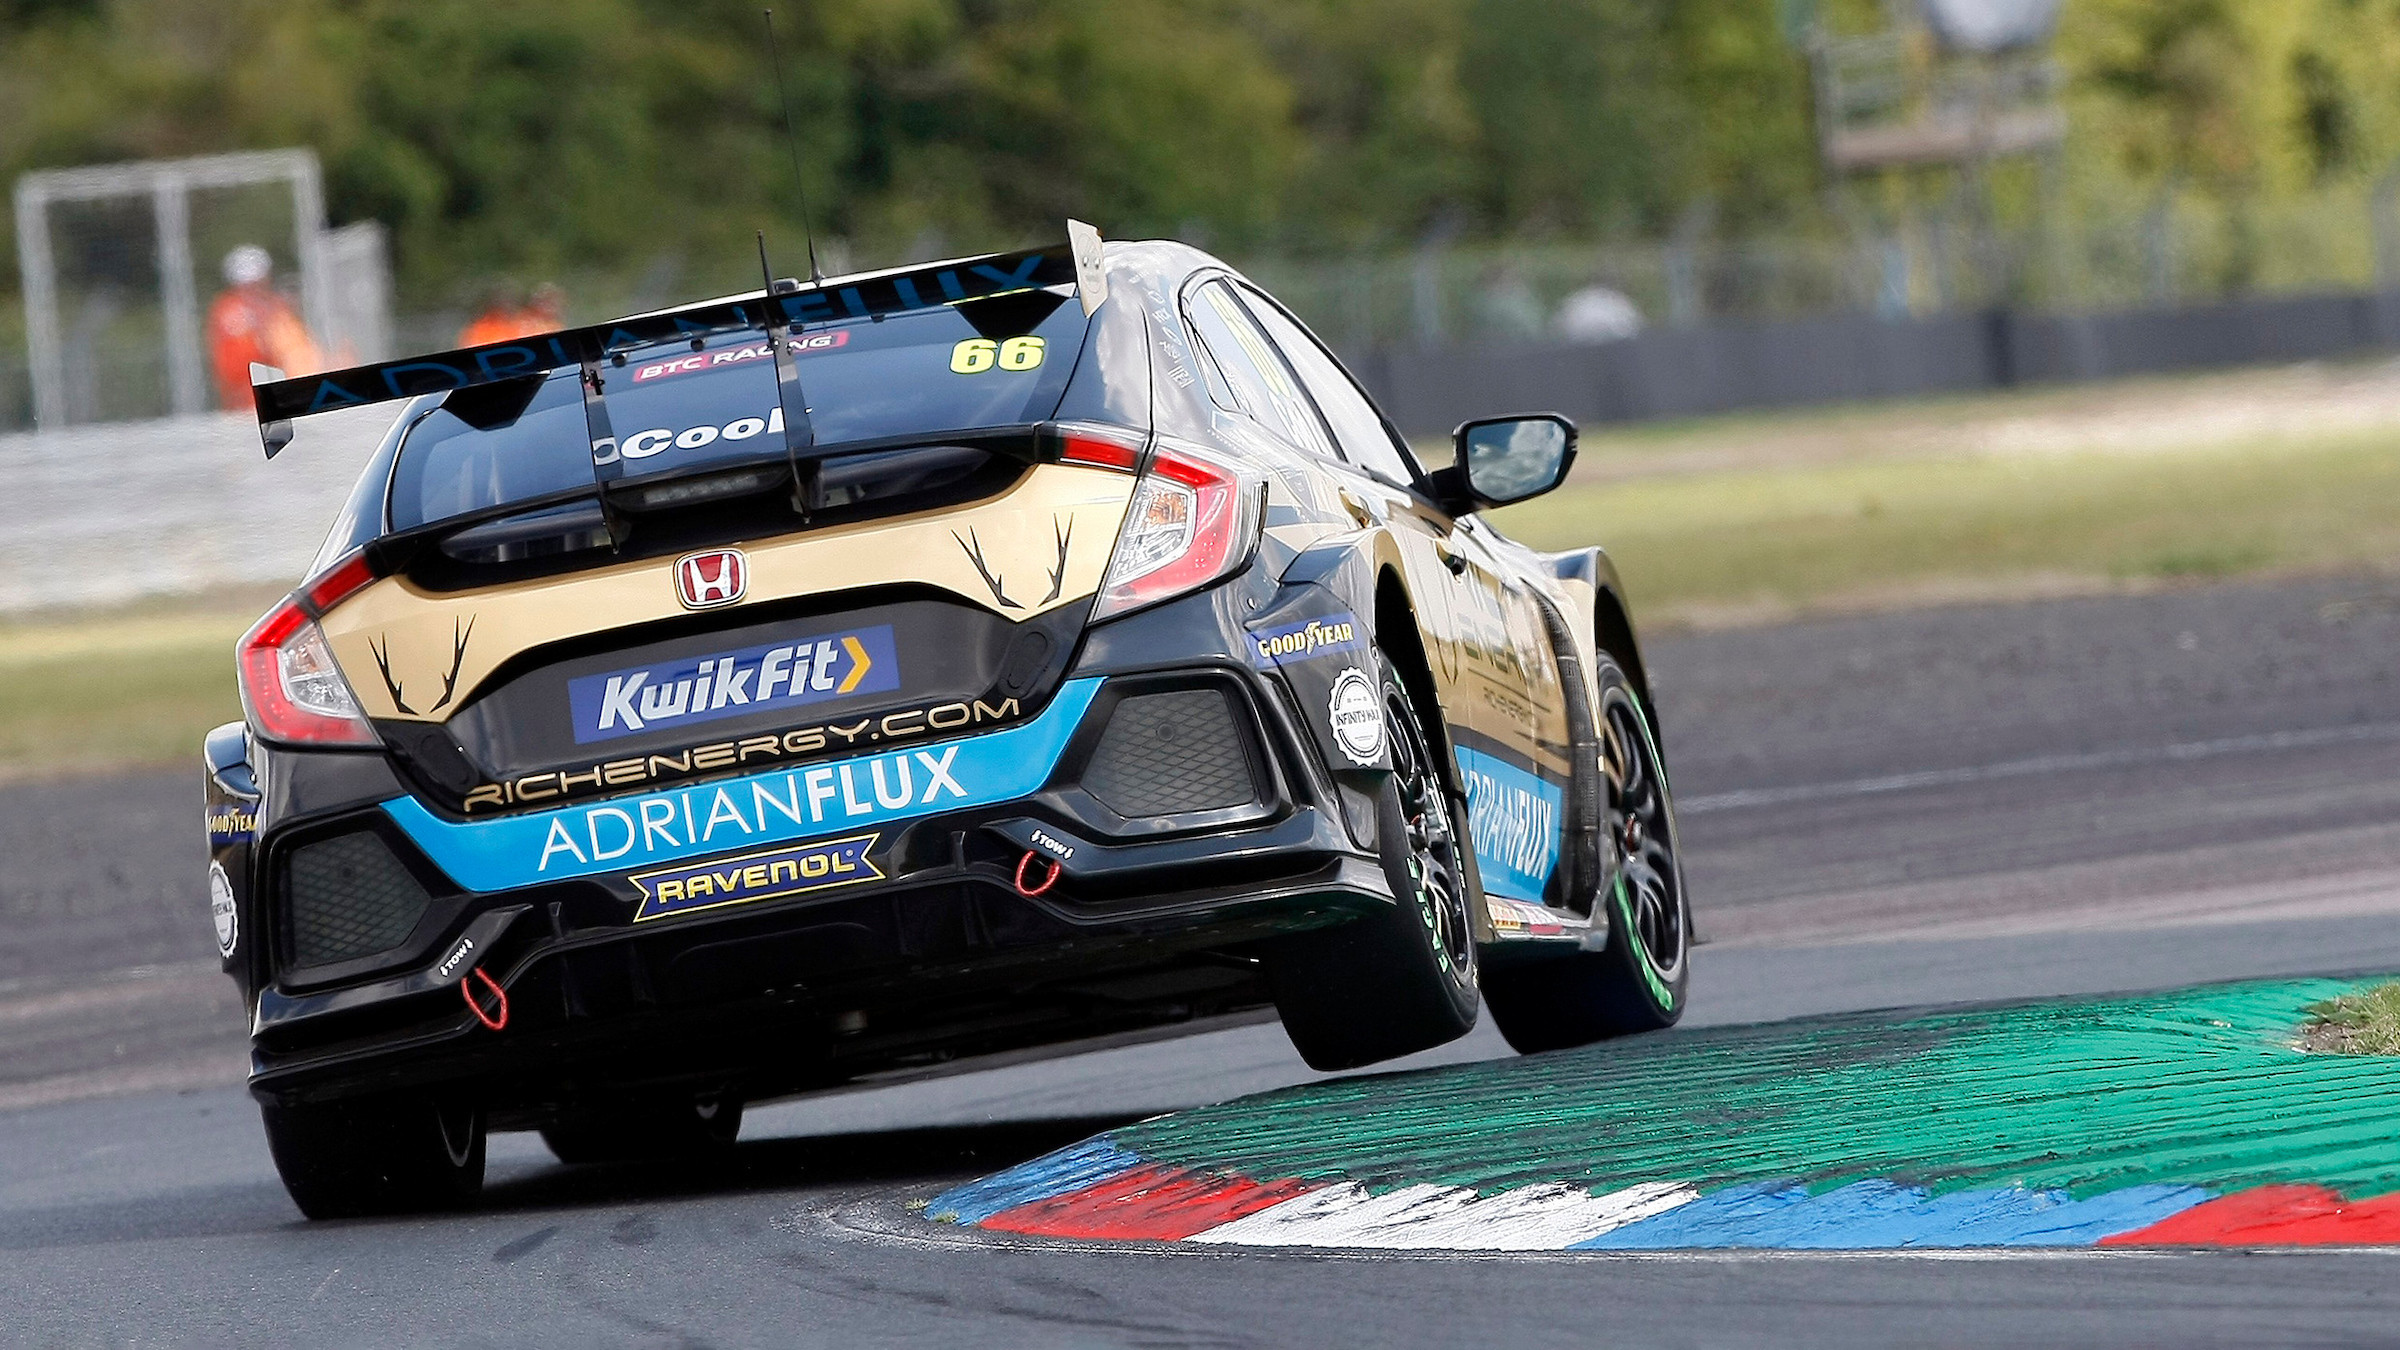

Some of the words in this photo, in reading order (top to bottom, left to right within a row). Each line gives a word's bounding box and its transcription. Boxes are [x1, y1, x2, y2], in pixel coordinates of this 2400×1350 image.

[640, 357, 703, 380] BTC
[712, 335, 833, 364] RACNG
[949, 335, 1047, 374] 66
[1257, 621, 1354, 655] GOODYEAR
[464, 698, 1021, 812] RICHENERGY.COM
[538, 745, 968, 872] ADRIANFLUX
[1461, 769, 1551, 880] DRIANFLUX
[1039, 834, 1068, 855] TOW
[657, 853, 855, 906] RAVENOL
[445, 944, 468, 970] TOW
